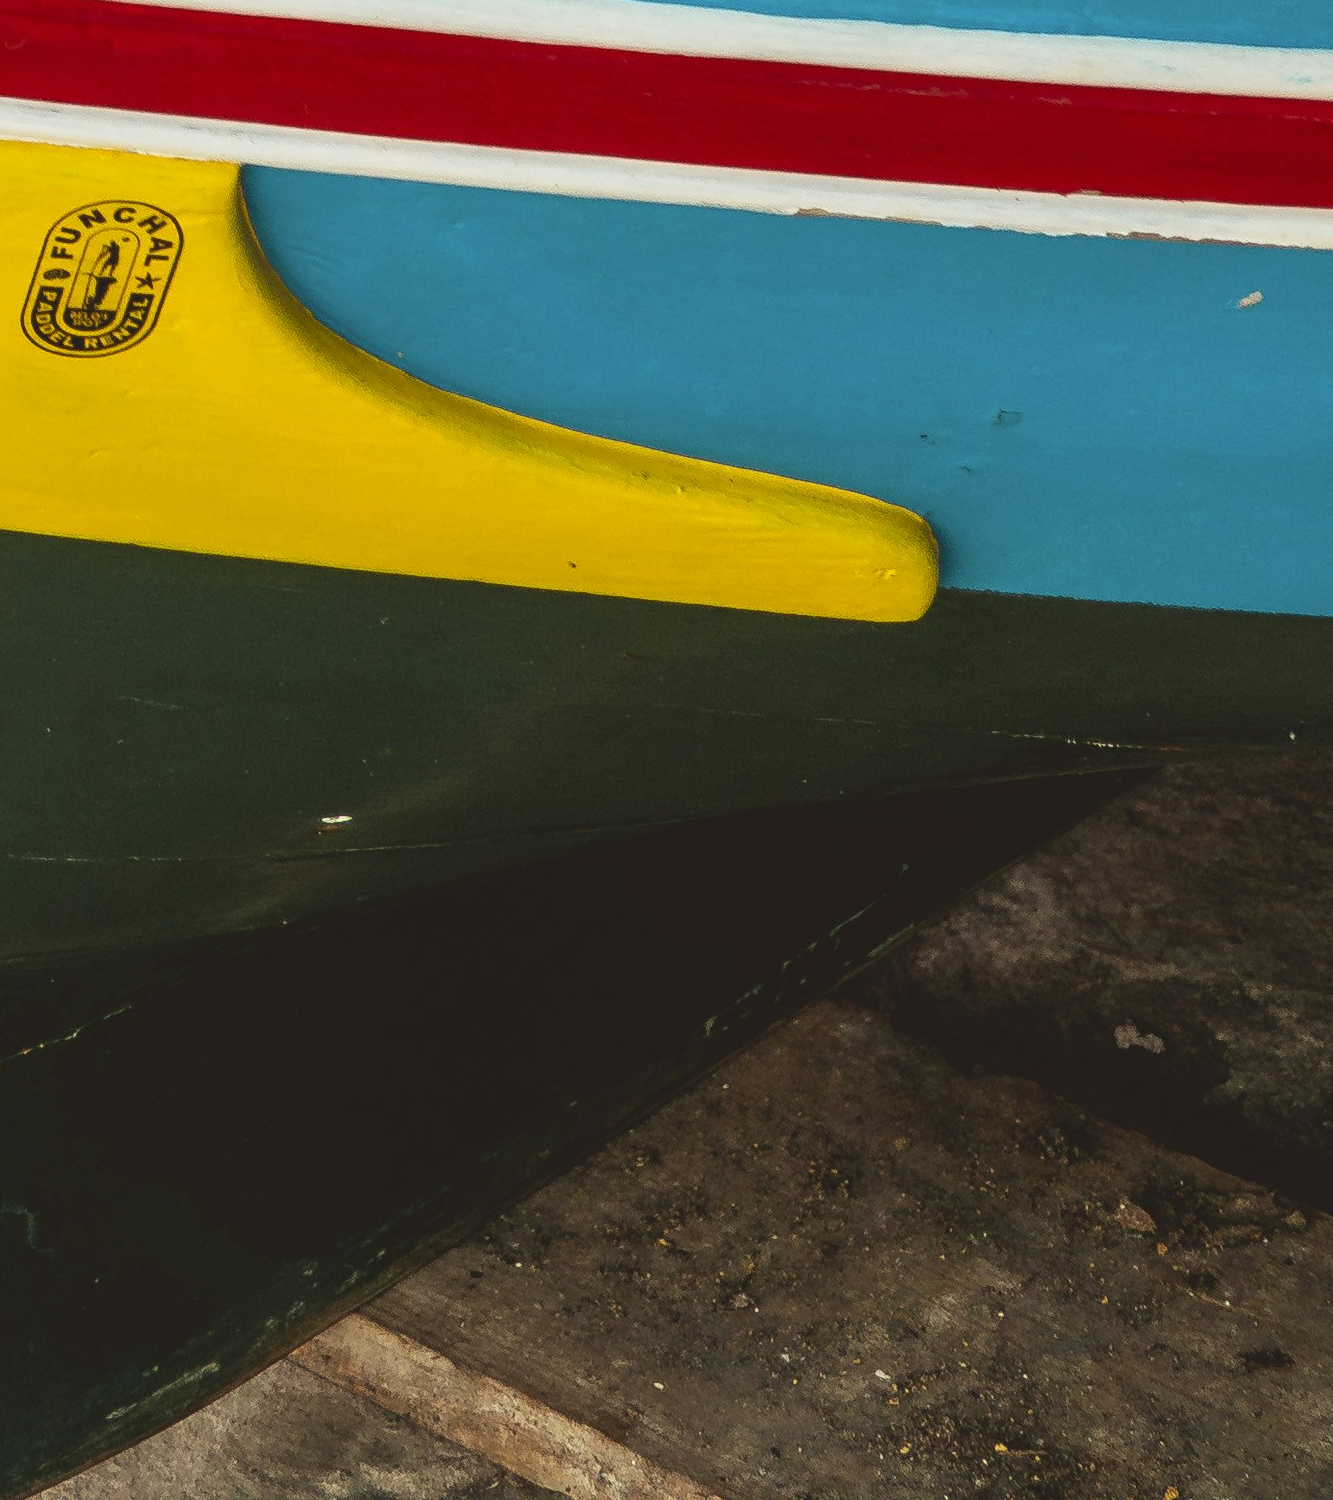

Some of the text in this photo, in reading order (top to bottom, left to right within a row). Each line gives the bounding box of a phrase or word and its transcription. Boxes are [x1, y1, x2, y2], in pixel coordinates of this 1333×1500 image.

[51, 207, 173, 267] FUNCHAL
[35, 290, 149, 349] PADDEL RENTAL
